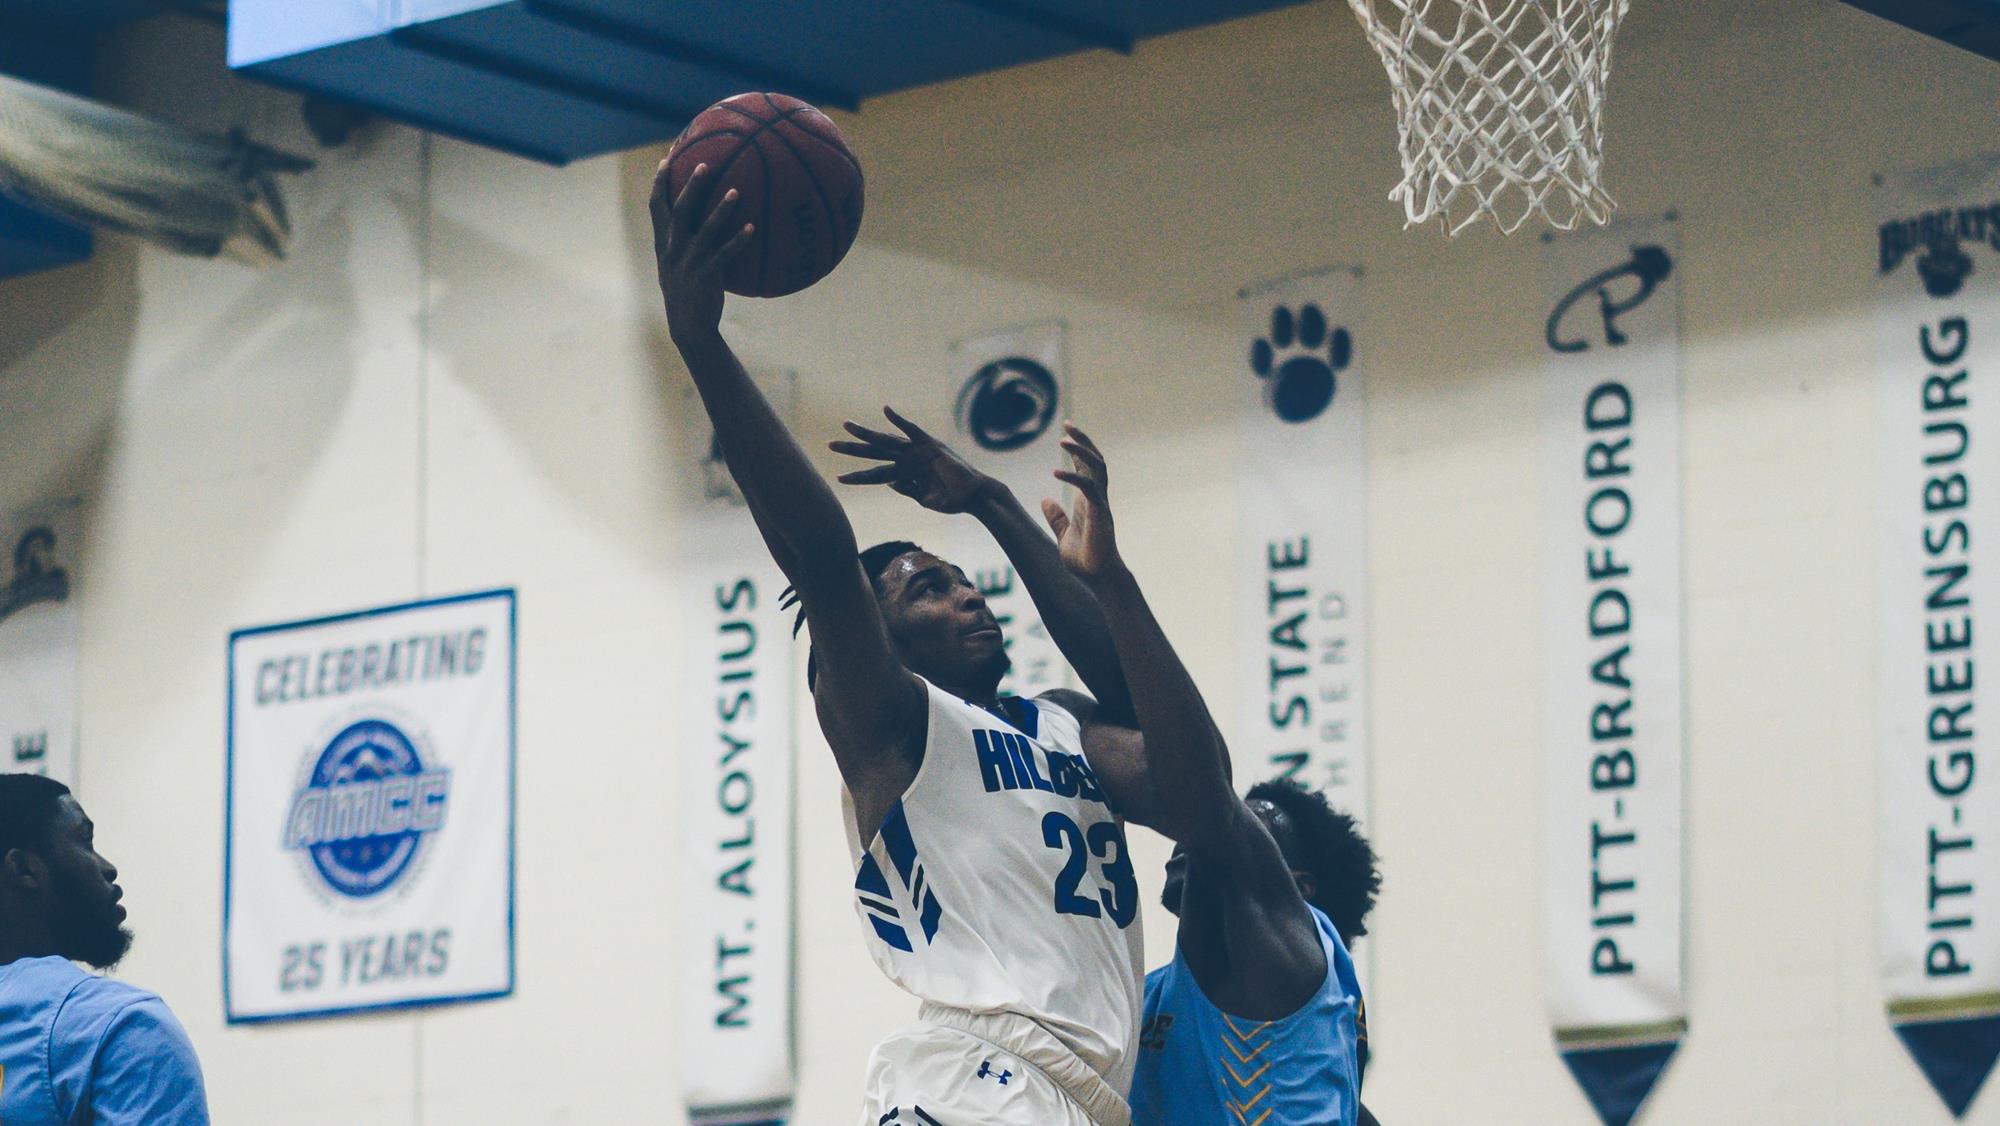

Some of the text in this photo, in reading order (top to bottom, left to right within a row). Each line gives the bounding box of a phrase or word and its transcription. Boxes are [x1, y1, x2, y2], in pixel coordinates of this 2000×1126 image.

[254, 628, 487, 706] CELEBRATING
[1266, 536, 1311, 729] STATE
[1319, 591, 1348, 787] HREND
[1583, 380, 1636, 976] PITT-BRADFORD
[1920, 314, 1974, 978] PITT-GREENSBURG
[715, 576, 757, 1029] MT. ALOYSIUS
[1042, 811, 1138, 929] 23
[278, 928, 452, 993] 25 YEARS
